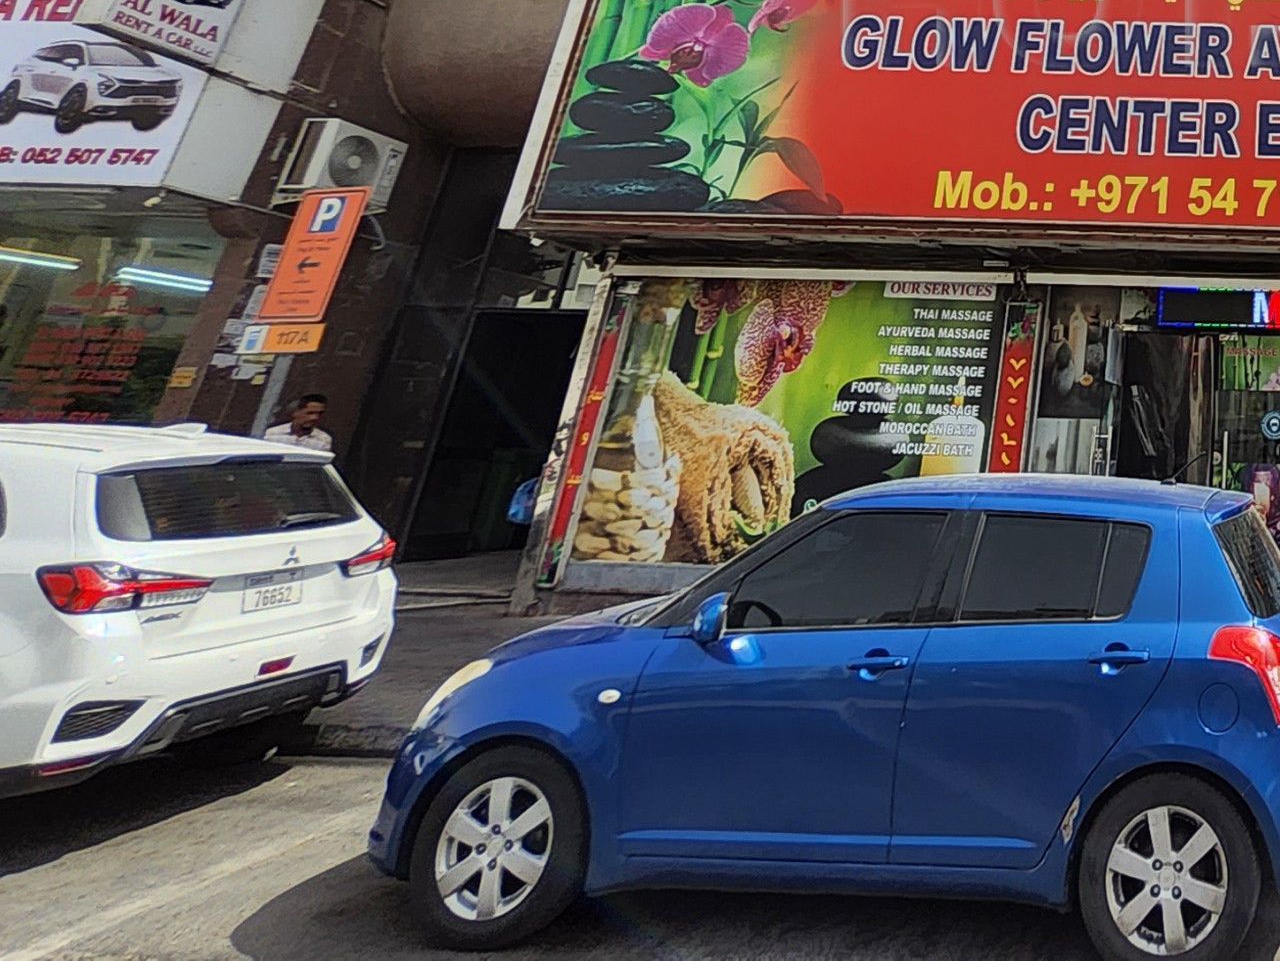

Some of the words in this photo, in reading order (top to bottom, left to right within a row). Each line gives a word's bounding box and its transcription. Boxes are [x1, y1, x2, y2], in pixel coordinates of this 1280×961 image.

[112, 10, 155, 34] RENT
[153, 26, 164, 40] A
[165, 31, 194, 51] CAR
[159, 3, 220, 43] WALA
[840, 14, 1003, 72] GLOW
[1011, 18, 1233, 80] FLOWER
[1015, 93, 1242, 158] CENTER
[21, 147, 63, 165] 052
[64, 147, 107, 165] 507
[107, 148, 160, 166] 5747
[933, 169, 1056, 212] Mob.:
[1068, 174, 1170, 216] +971
[1188, 177, 1239, 217] 54
[311, 197, 342, 232] P
[890, 282, 922, 295] OUR
[924, 282, 993, 297] SERVICES
[913, 308, 939, 320] THAI
[940, 309, 994, 322] MASSAGE
[877, 326, 936, 338] AYURVEDA
[937, 327, 991, 340] MASSAGE
[889, 344, 932, 357] HERBAL
[935, 346, 989, 359] MASSAGE
[878, 363, 930, 376] THERAPY
[932, 365, 986, 378] MASSAGE
[850, 381, 880, 394] FOOT
[881, 382, 893, 394] &
[895, 383, 926, 395] HAND
[928, 384, 983, 398] MASSAGE
[832, 400, 857, 413] HOT
[858, 401, 896, 414] STONE
[904, 402, 923, 415] OIL
[925, 404, 980, 417] MASSAGE
[879, 421, 945, 435] MOROCCAN
[945, 424, 977, 436] BATH
[891, 442, 940, 456] JACUZZI
[943, 444, 974, 456] BATH
